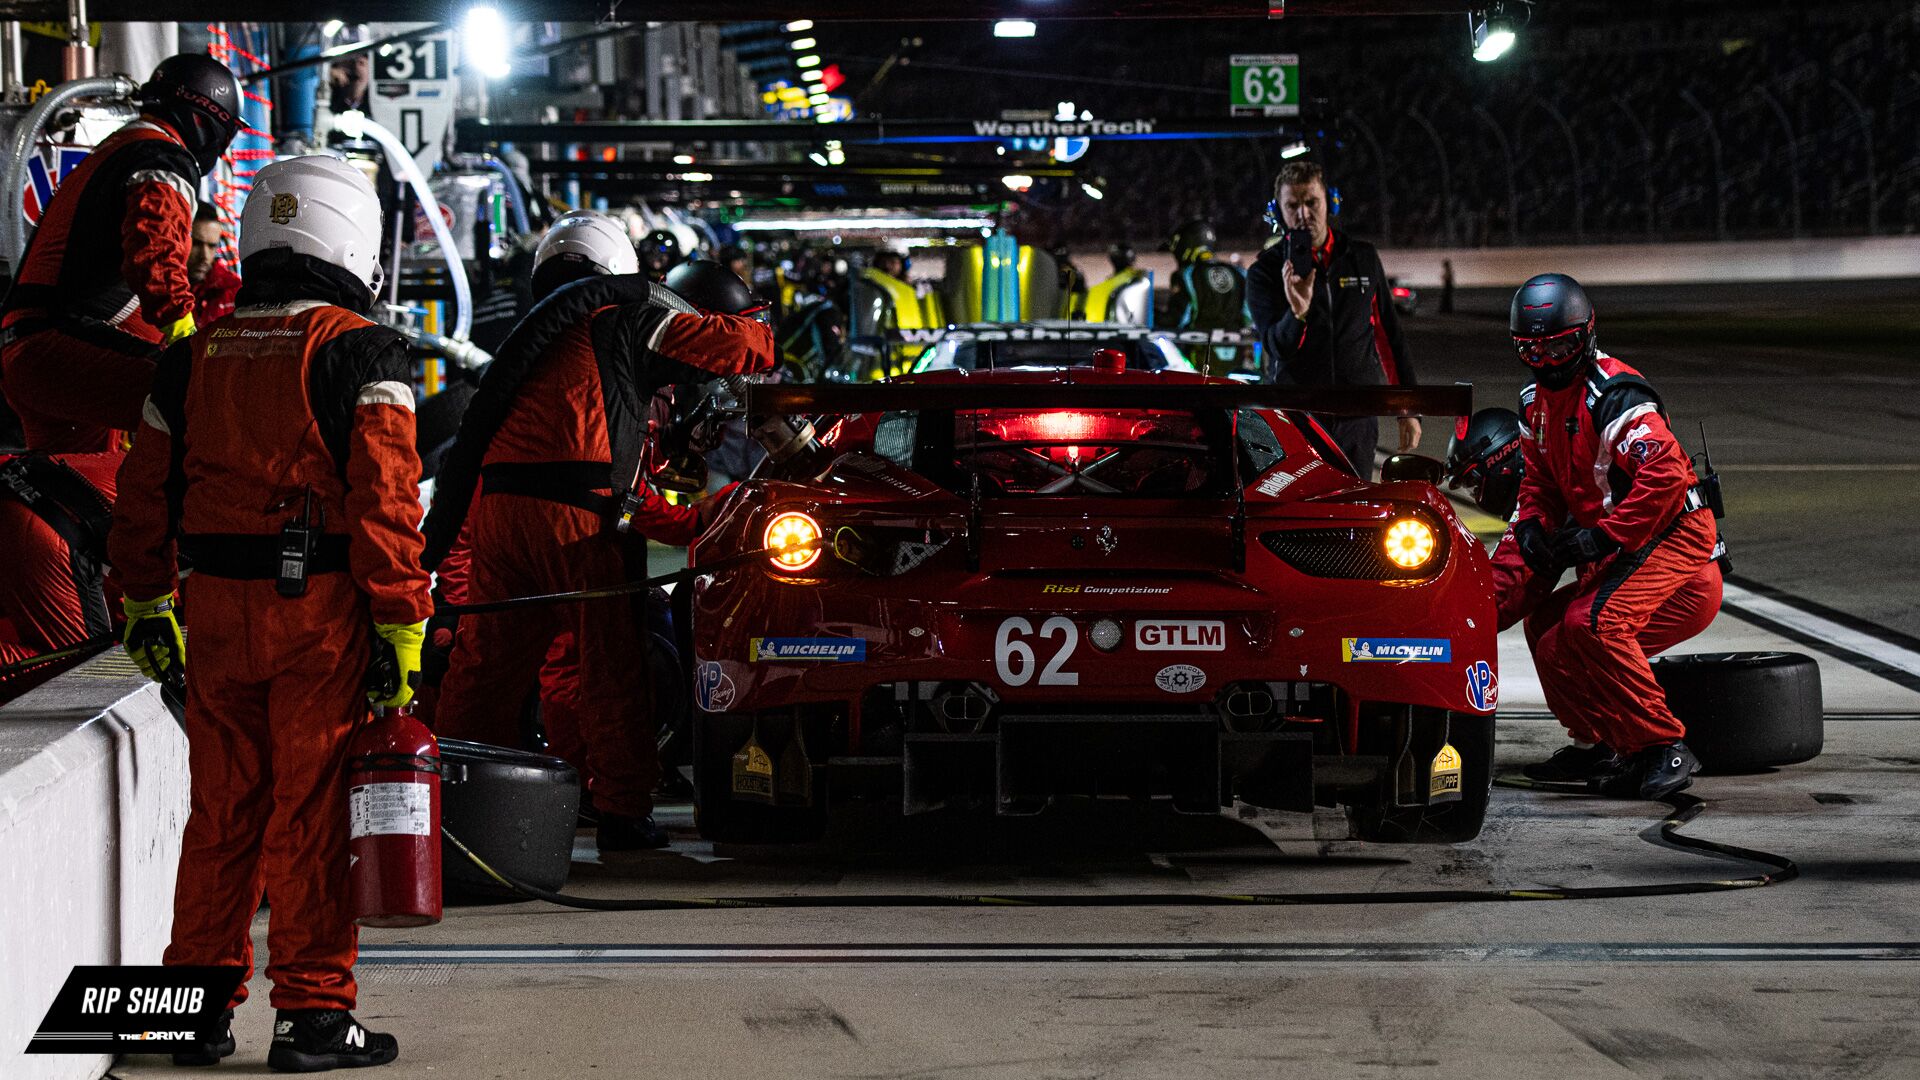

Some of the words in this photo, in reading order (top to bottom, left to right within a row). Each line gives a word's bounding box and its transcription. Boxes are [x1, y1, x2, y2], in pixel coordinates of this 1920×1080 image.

[386, 41, 436, 79] 31
[1244, 67, 1286, 103] 63
[974, 119, 1153, 136] WeatherTech
[211, 328, 241, 337] Risi
[240, 328, 304, 339] Competizione
[901, 329, 1241, 342] WeatherTech
[1485, 438, 1520, 468] RURO
[1042, 584, 1081, 593] Risi
[1083, 586, 1170, 595] Competizione
[1140, 625, 1221, 646] GTLM
[780, 645, 856, 655] MICHELIN
[995, 616, 1079, 686] 62
[1376, 645, 1443, 656] MICHELIN
[697, 661, 722, 710] VP
[1466, 660, 1490, 710] VP
[345, 1024, 366, 1048] N
